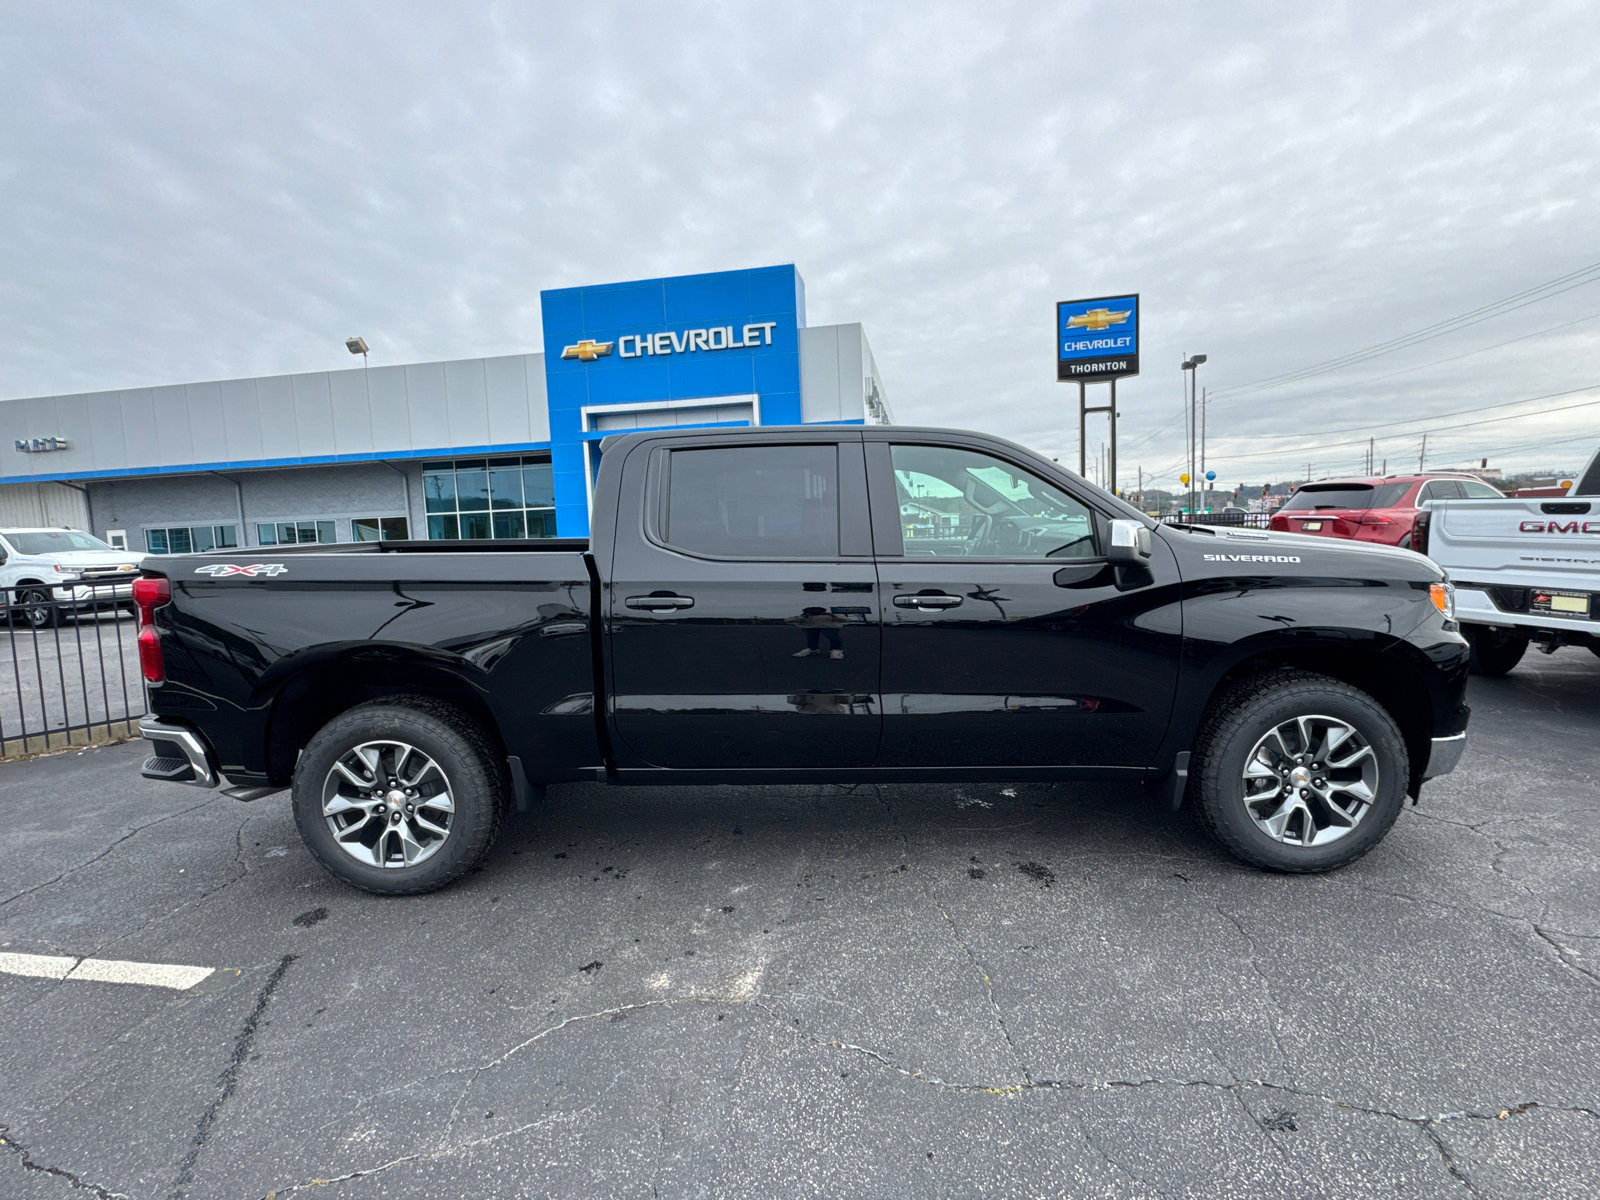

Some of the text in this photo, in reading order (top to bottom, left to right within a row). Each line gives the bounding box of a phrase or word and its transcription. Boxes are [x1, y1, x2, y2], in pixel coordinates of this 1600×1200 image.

[618, 322, 777, 358] CHEVROLET
[1064, 336, 1132, 352] CHEVROLET
[1070, 361, 1127, 374] THORNTON
[15, 437, 58, 453] PARTS
[1519, 521, 1600, 534] GMC
[1203, 554, 1301, 564] SILVERADO
